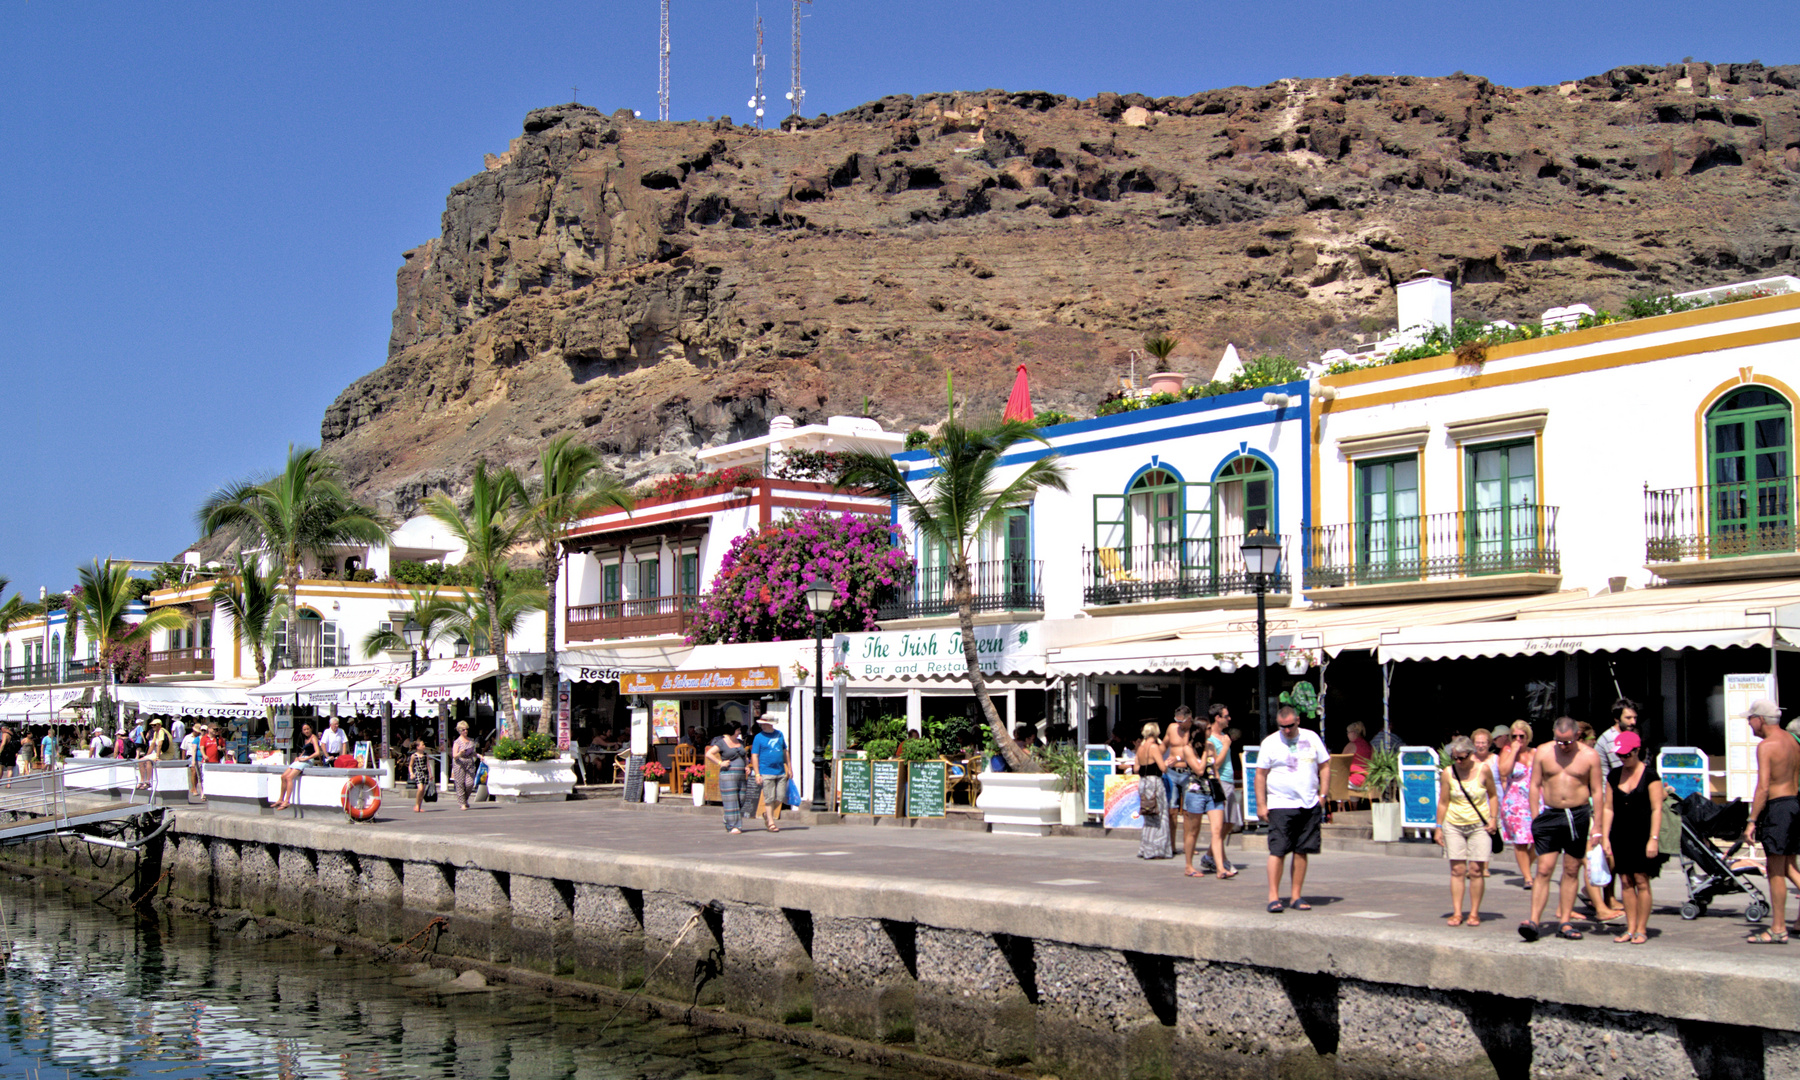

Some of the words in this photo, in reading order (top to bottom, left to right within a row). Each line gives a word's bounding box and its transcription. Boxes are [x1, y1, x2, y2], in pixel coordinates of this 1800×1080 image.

[862, 636, 890, 659] The
[899, 633, 938, 657] Irish
[948, 631, 1004, 655] Taern
[1540, 638, 1582, 652] Tortuga
[448, 658, 480, 672] Paella
[865, 664, 885, 674] Bar
[895, 663, 917, 673] and
[927, 660, 998, 672] Restauant
[291, 671, 315, 682] Tapas
[333, 668, 380, 679] Restaurante
[309, 693, 338, 702] Restaurante
[360, 692, 367, 701] La
[421, 687, 451, 698] Paella
[261, 695, 283, 704] Tapas
